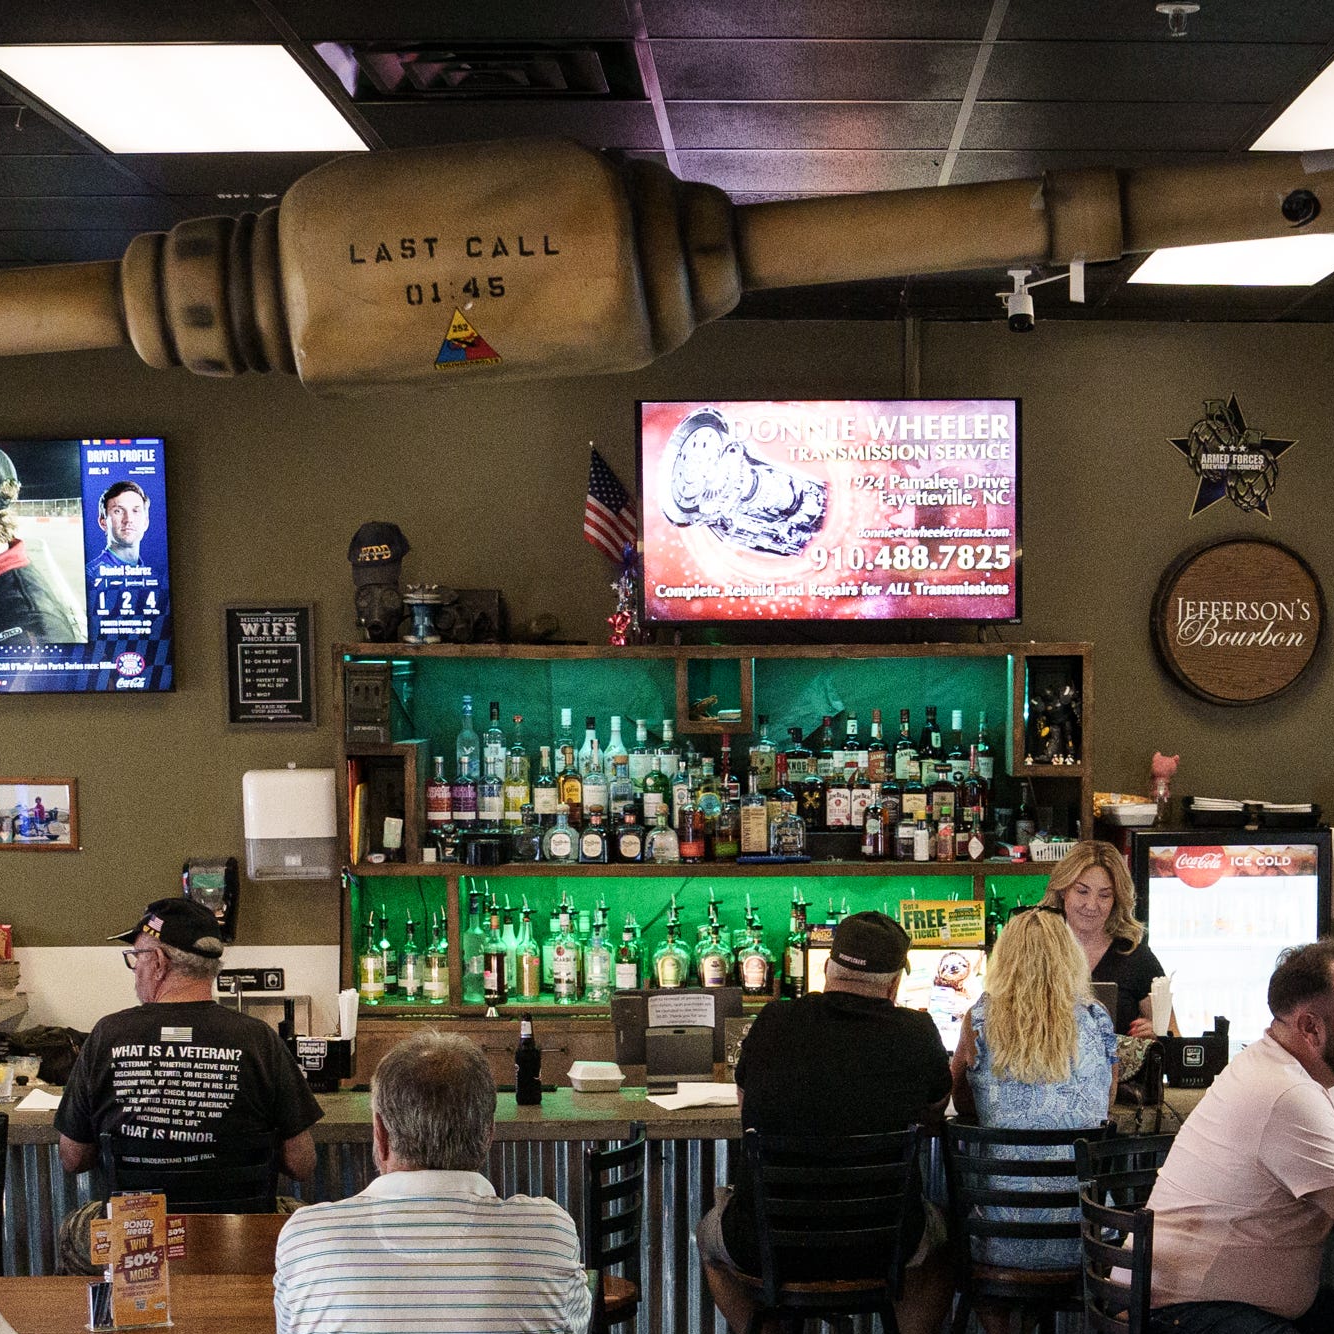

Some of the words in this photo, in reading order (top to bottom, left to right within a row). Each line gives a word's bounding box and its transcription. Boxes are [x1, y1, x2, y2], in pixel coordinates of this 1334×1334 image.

[349, 237, 439, 266] LAST
[466, 232, 561, 260] CALL
[405, 275, 506, 306] 01:45
[452, 322, 469, 333] 252
[727, 416, 856, 442] DONNIE
[867, 414, 1011, 440] WHEELER
[87, 449, 119, 463] DRIVER
[120, 449, 155, 462] PROFILE
[787, 444, 929, 461] TRANSMISSION
[934, 443, 1010, 460] SERVICE
[1201, 453, 1230, 465] ARMED
[1232, 453, 1265, 465] FORCES
[846, 475, 885, 490] 1924
[889, 473, 959, 490] Pamalee
[964, 473, 1010, 489] Drive
[878, 488, 977, 511] Fayetteville,
[983, 489, 1011, 505] NC
[811, 545, 1011, 571] 910.488.7825
[99, 565, 124, 576] Daniel
[655, 584, 722, 601] Complete
[724, 582, 776, 598] Rebuild
[779, 582, 804, 597] and
[808, 582, 859, 599] Repairs
[861, 582, 883, 596] for
[886, 582, 911, 596] ALL
[915, 581, 1010, 596] Transmissions
[122, 591, 132, 609] 2
[146, 590, 156, 609] 4
[1177, 597, 1311, 626] JEFFERSON'S
[240, 622, 298, 636] WIFE
[1176, 612, 1307, 648] Bourbon
[1175, 852, 1225, 870] Coca-Cola
[1230, 856, 1252, 867] ICE
[1255, 856, 1292, 867] COLD
[903, 909, 947, 930] FREE
[914, 928, 941, 940] TICKET
[111, 1044, 146, 1059] WHAT
[148, 1044, 162, 1057] IS
[165, 1045, 175, 1058] A
[178, 1045, 243, 1061] VETERAN?
[159, 1061, 192, 1070] WHETHER
[193, 1062, 219, 1071] ACTIVE
[219, 1063, 241, 1073] DUTY,
[194, 1072, 224, 1080] RESERVE
[181, 1081, 202, 1089] POINT
[163, 1088, 186, 1097] CHECK
[187, 1090, 206, 1099] MADE
[207, 1092, 236, 1100] PAYABLE
[162, 1097, 187, 1107] STATES
[143, 1106, 171, 1115] AMOUNT
[136, 1114, 171, 1125] INCLUDING
[121, 1123, 150, 1140] THAT
[152, 1128, 166, 1141] IS
[169, 1129, 217, 1143] HONOR.
[123, 1219, 155, 1229] BONUS
[167, 1227, 186, 1237] 50%
[129, 1237, 149, 1250] WIN
[167, 1235, 186, 1245] MORE
[123, 1250, 159, 1269] 50%
[129, 1266, 155, 1282] MORE
